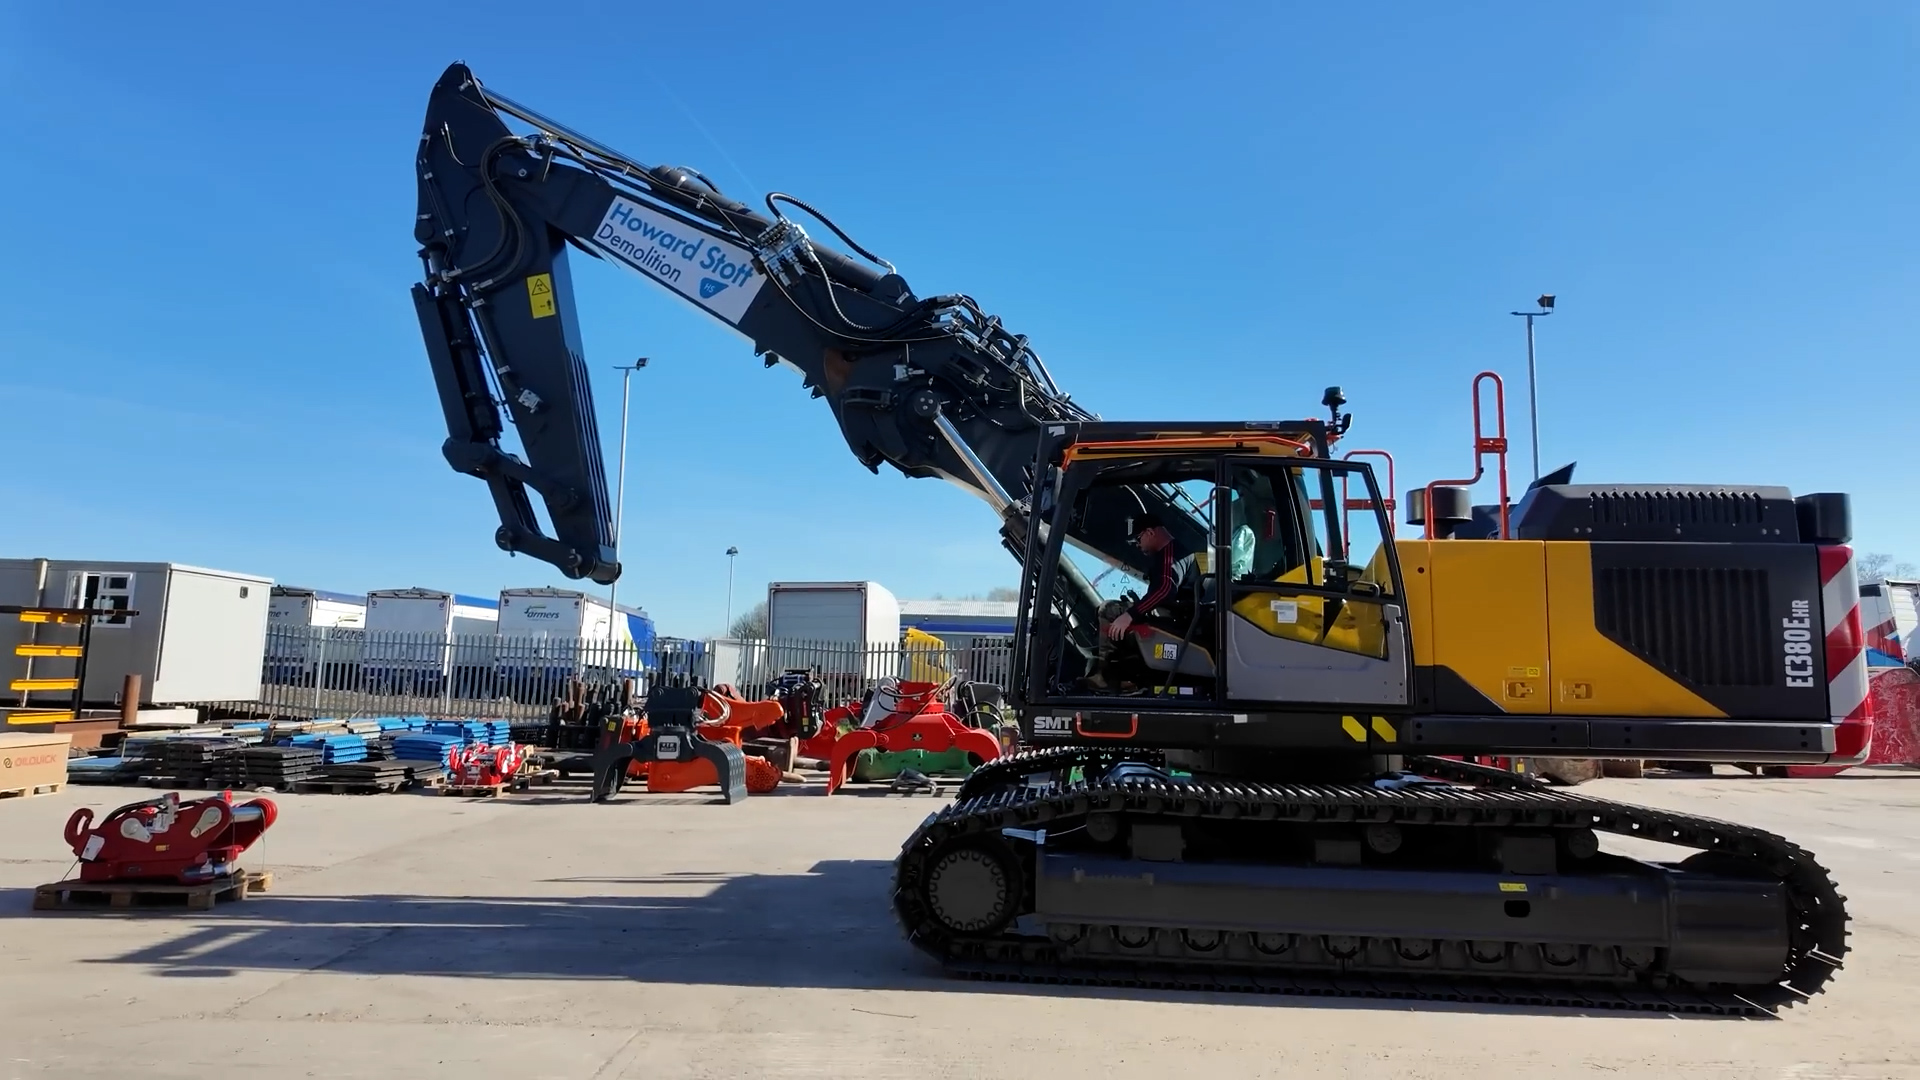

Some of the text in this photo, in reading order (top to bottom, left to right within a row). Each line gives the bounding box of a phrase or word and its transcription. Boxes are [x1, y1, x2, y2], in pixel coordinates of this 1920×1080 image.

[597, 223, 682, 282] Demolition
[609, 203, 753, 288] Howard Stott
[704, 283, 716, 293] HS
[1033, 716, 1073, 730] SMT
